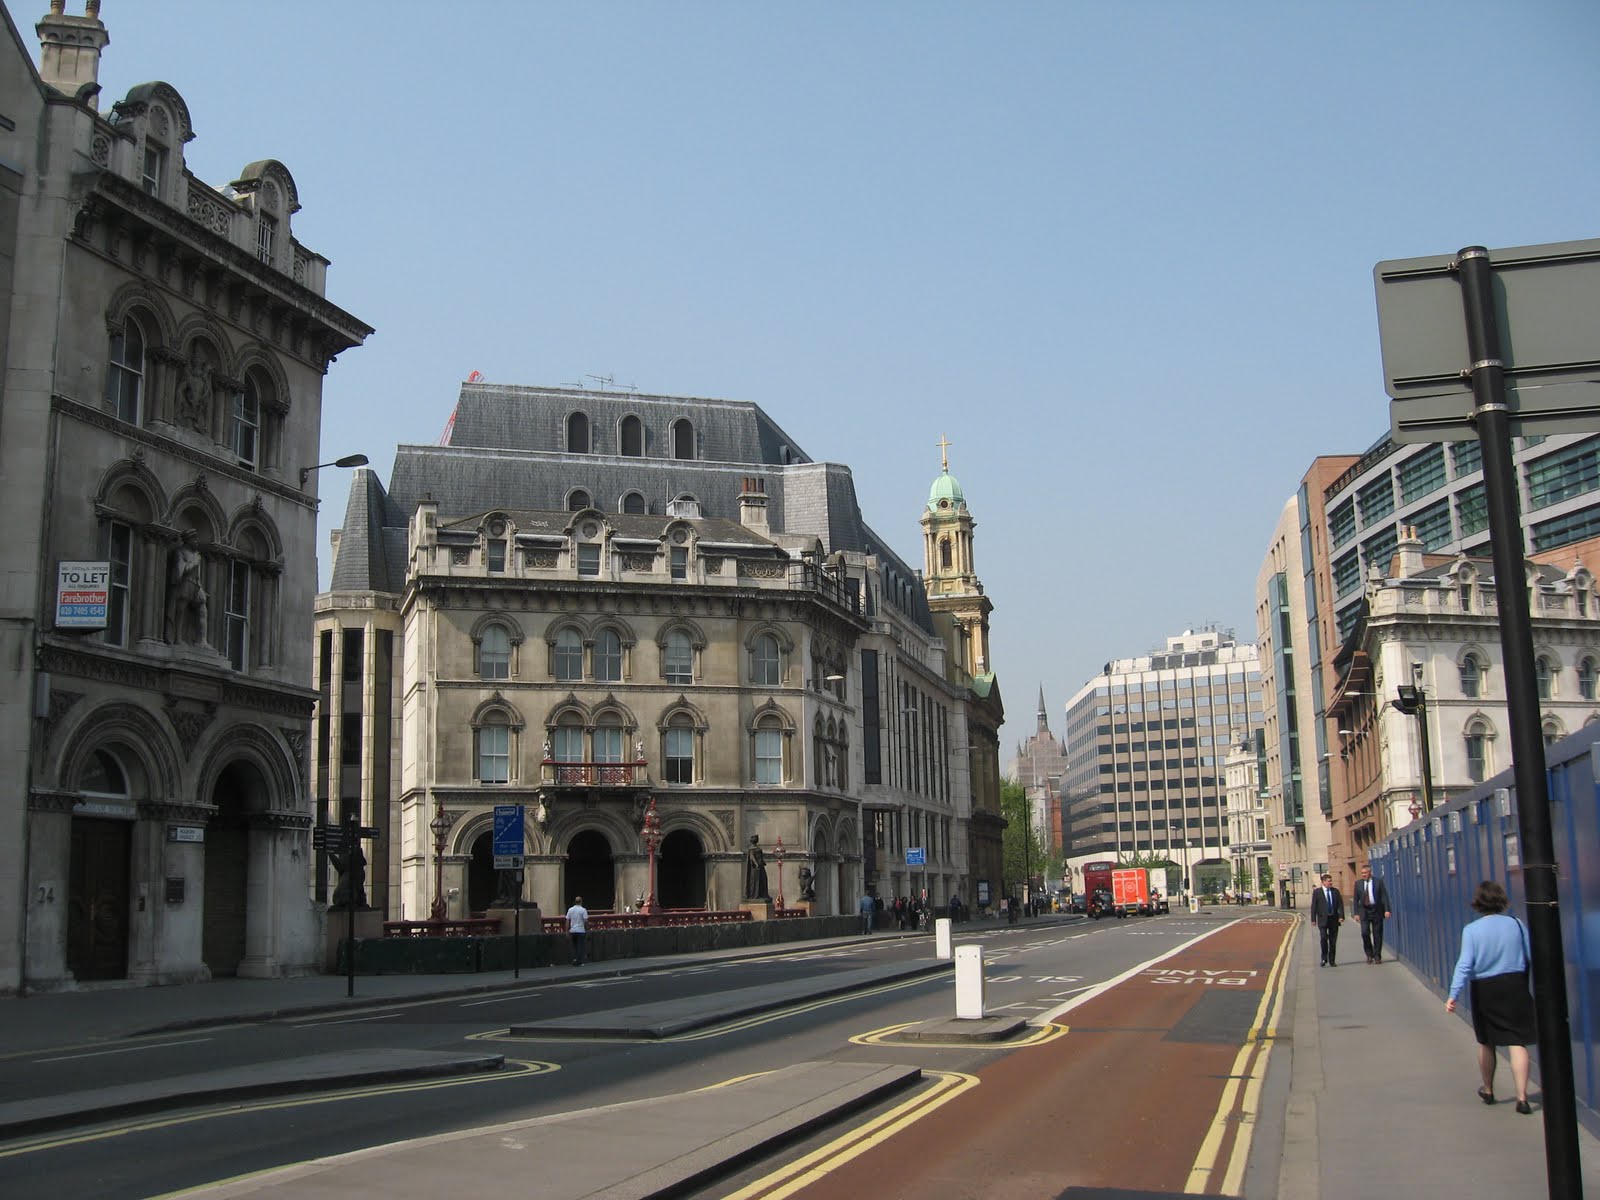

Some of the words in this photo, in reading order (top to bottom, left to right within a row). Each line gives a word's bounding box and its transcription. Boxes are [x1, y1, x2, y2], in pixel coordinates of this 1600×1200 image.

[61, 573, 80, 583] TO
[84, 573, 108, 583] LET
[61, 592, 105, 603] Farebrother
[60, 607, 72, 615] 020
[73, 607, 88, 615] 7405
[89, 607, 104, 615] 4545
[38, 887, 54, 903] 24
[946, 975, 1084, 983] SLO
[1151, 977, 1247, 985] BUS
